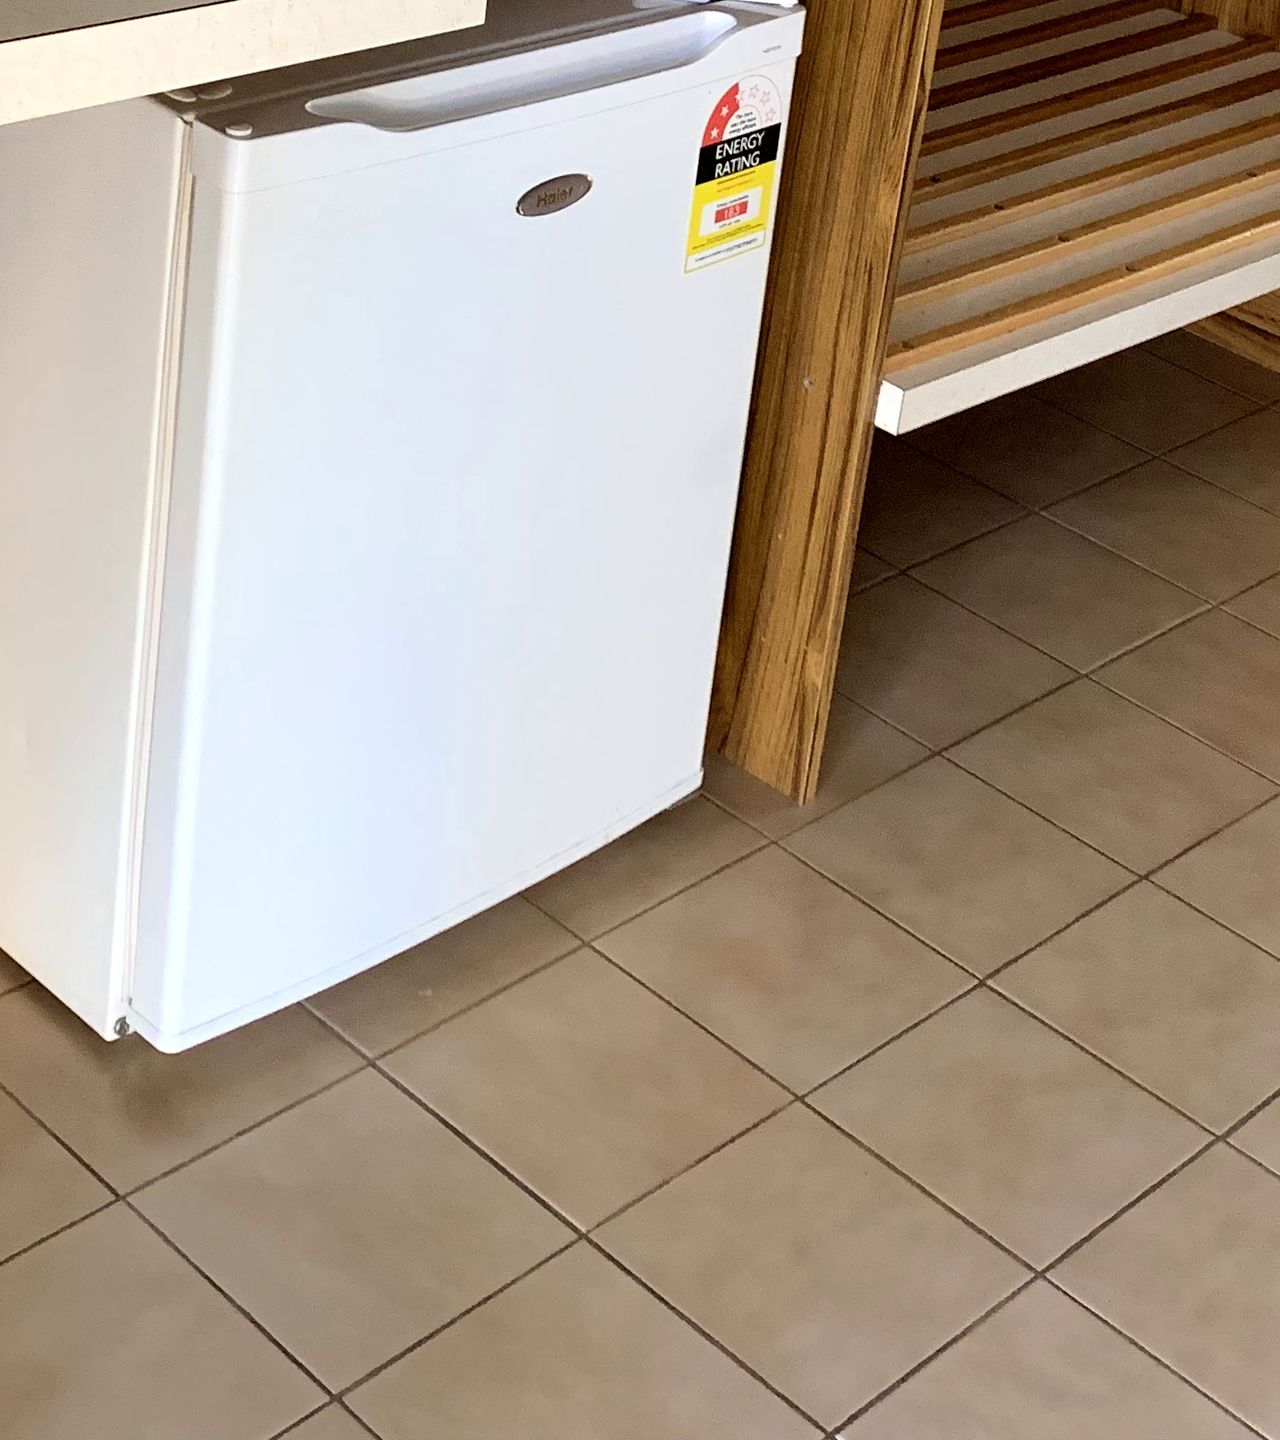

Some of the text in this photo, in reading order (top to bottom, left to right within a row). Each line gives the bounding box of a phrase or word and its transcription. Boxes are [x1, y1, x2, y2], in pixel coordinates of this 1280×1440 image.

[715, 130, 766, 161] ENERGY
[714, 150, 761, 179] RATING
[536, 186, 574, 208] Haier
